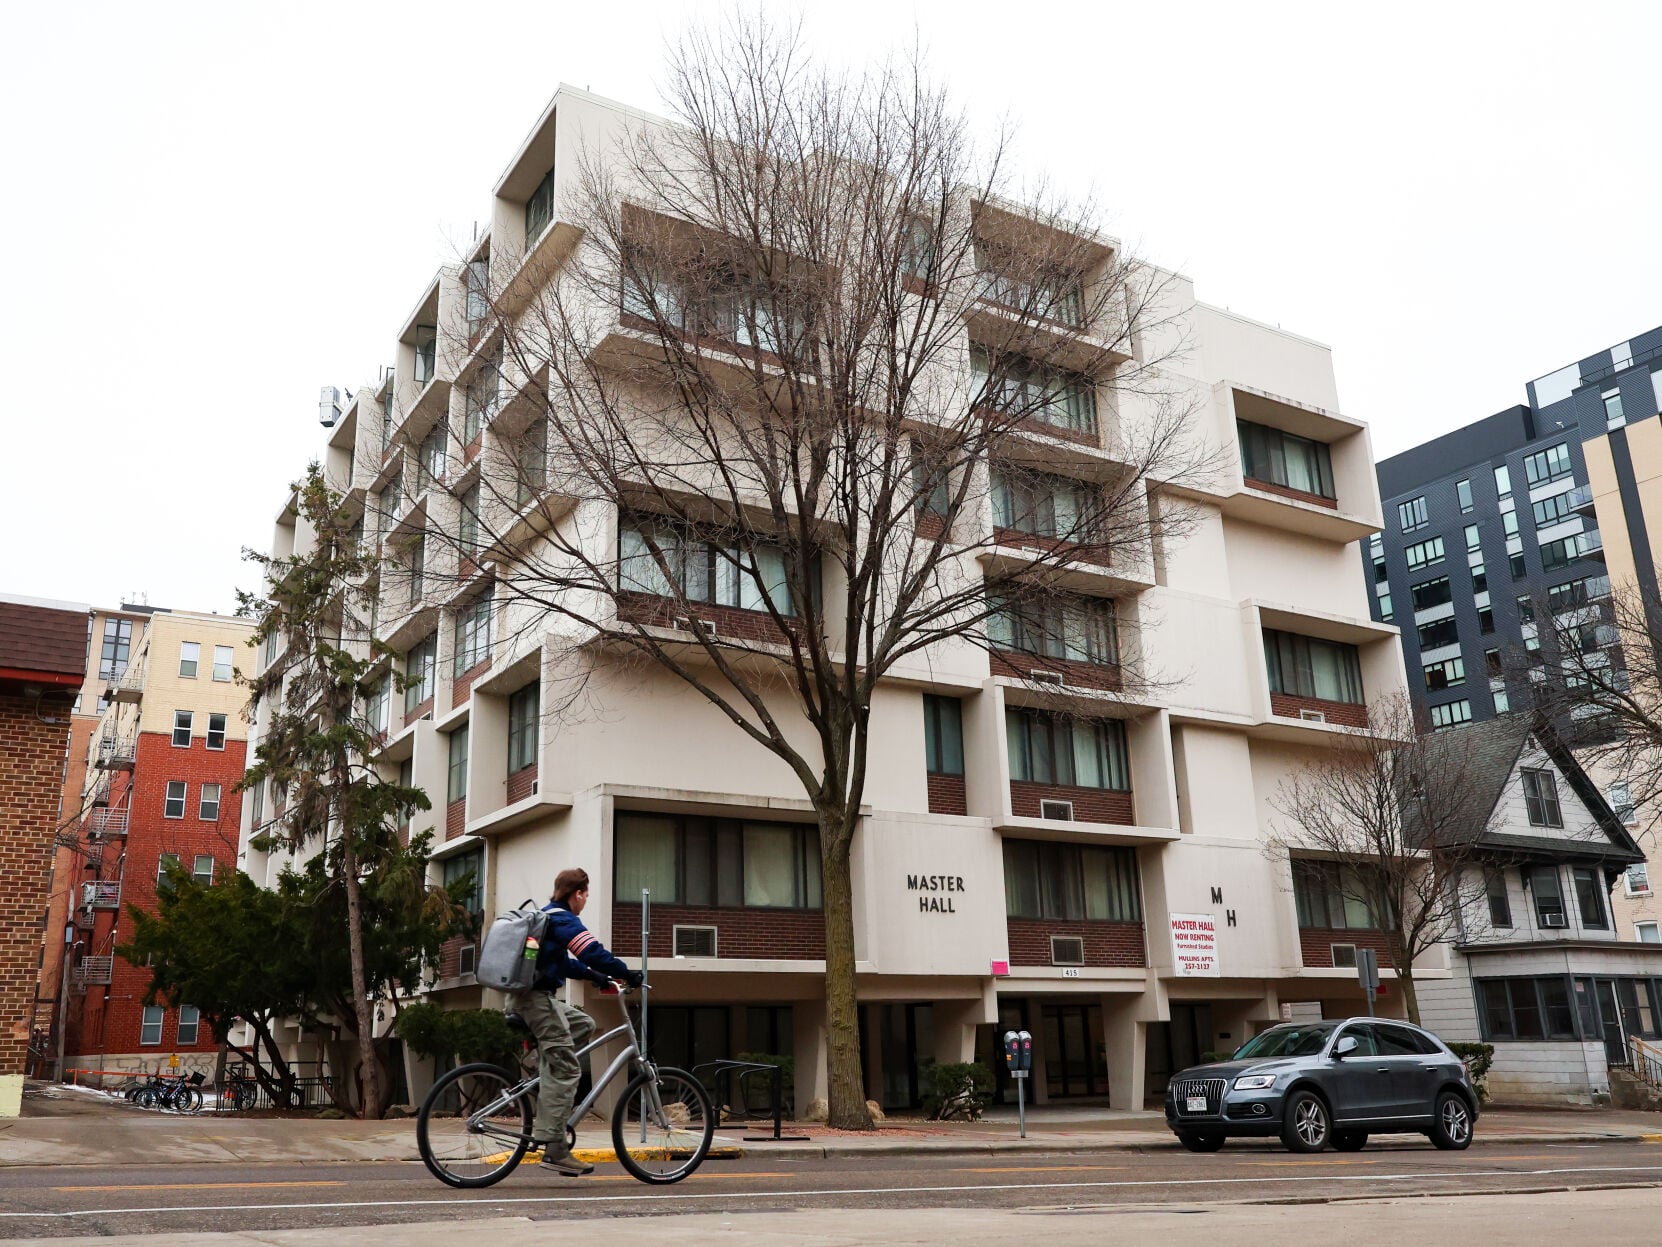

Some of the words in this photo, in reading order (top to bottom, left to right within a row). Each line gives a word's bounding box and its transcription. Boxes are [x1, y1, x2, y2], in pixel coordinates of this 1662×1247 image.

[907, 874, 965, 892] MASTER
[1211, 886, 1223, 905] M
[919, 896, 956, 913] HALL
[1171, 920, 1197, 930] MASTER
[1198, 921, 1215, 931] HALL
[1226, 909, 1237, 927] H
[1175, 933, 1189, 941] NOW
[1065, 968, 1078, 977] 415
